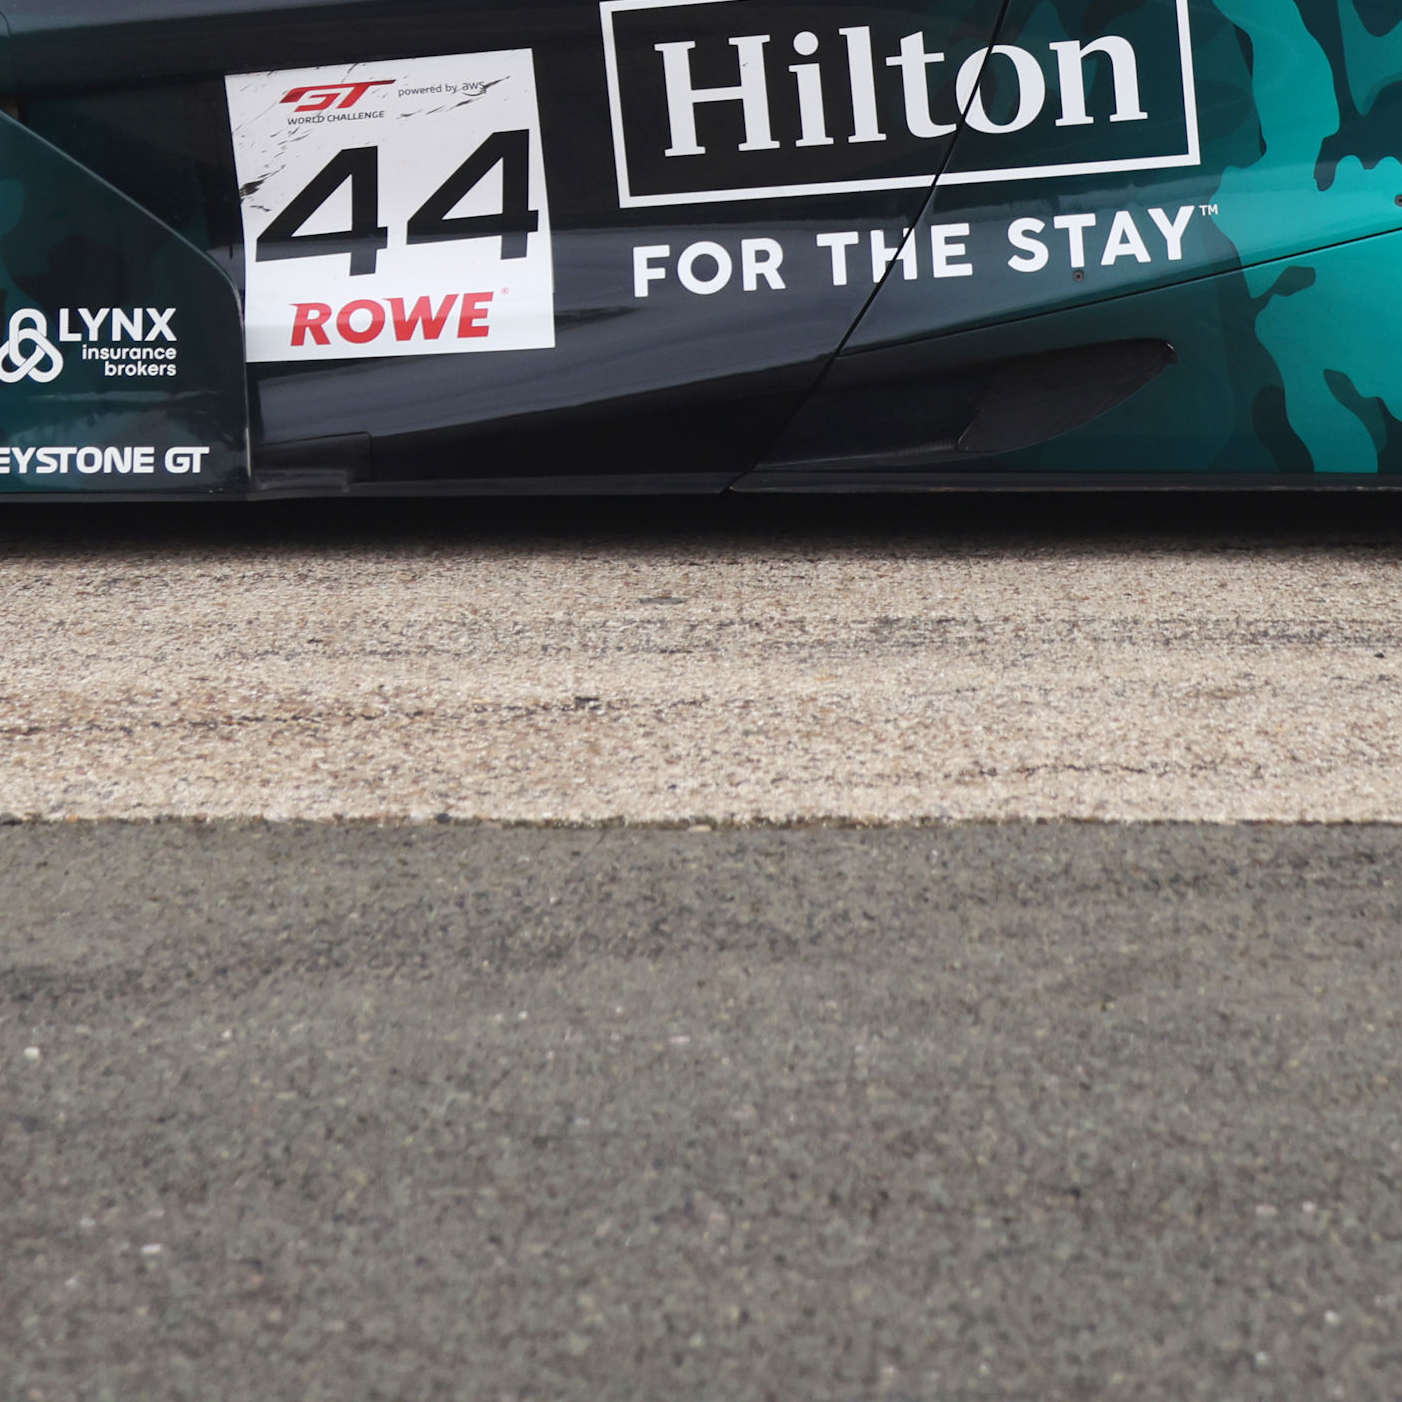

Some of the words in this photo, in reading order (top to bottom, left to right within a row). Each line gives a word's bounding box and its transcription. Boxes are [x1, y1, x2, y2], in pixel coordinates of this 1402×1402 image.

[398, 84, 443, 98] powered
[445, 83, 457, 95] by
[654, 25, 1148, 158] Hilton
[287, 115, 325, 126] WORLD
[326, 110, 385, 123] CHALLENGE
[254, 128, 540, 278] 44
[632, 236, 786, 298] FOR
[815, 222, 974, 287] THE
[1007, 204, 1196, 273] STAY
[58, 307, 178, 342] LYNX
[289, 291, 495, 348] ROWE
[81, 343, 177, 361] insurance
[104, 359, 177, 377] brokers
[163, 446, 210, 474] GT
